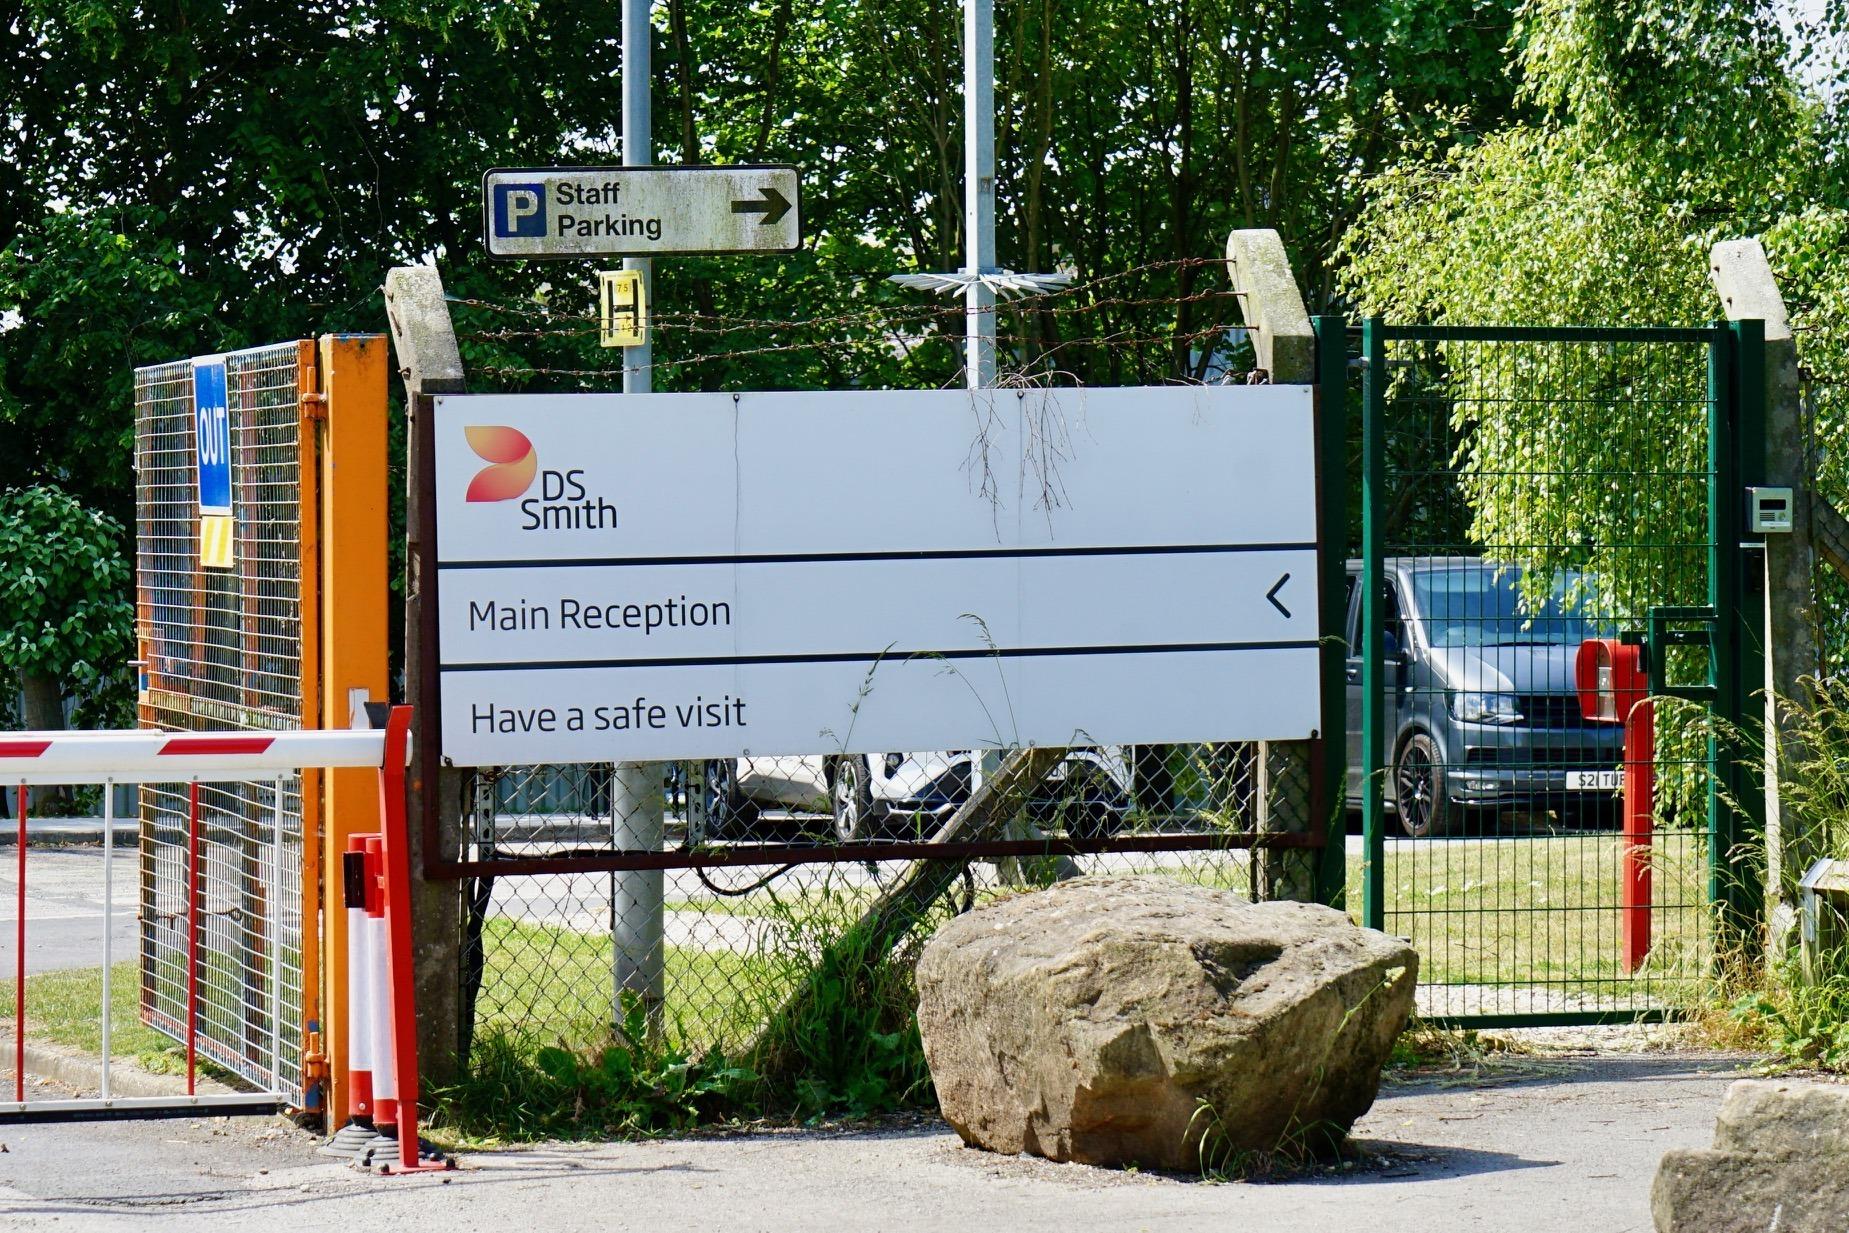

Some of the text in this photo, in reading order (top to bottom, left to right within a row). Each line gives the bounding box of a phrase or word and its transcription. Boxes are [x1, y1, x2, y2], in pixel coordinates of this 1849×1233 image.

[506, 189, 538, 232] P
[556, 182, 621, 205] Staff
[558, 214, 662, 240] Parking
[200, 407, 225, 466] OUT
[542, 469, 586, 501] DS
[521, 496, 617, 531] Smith
[469, 595, 730, 636] Main Reception
[471, 695, 747, 734] Have a safe visit
